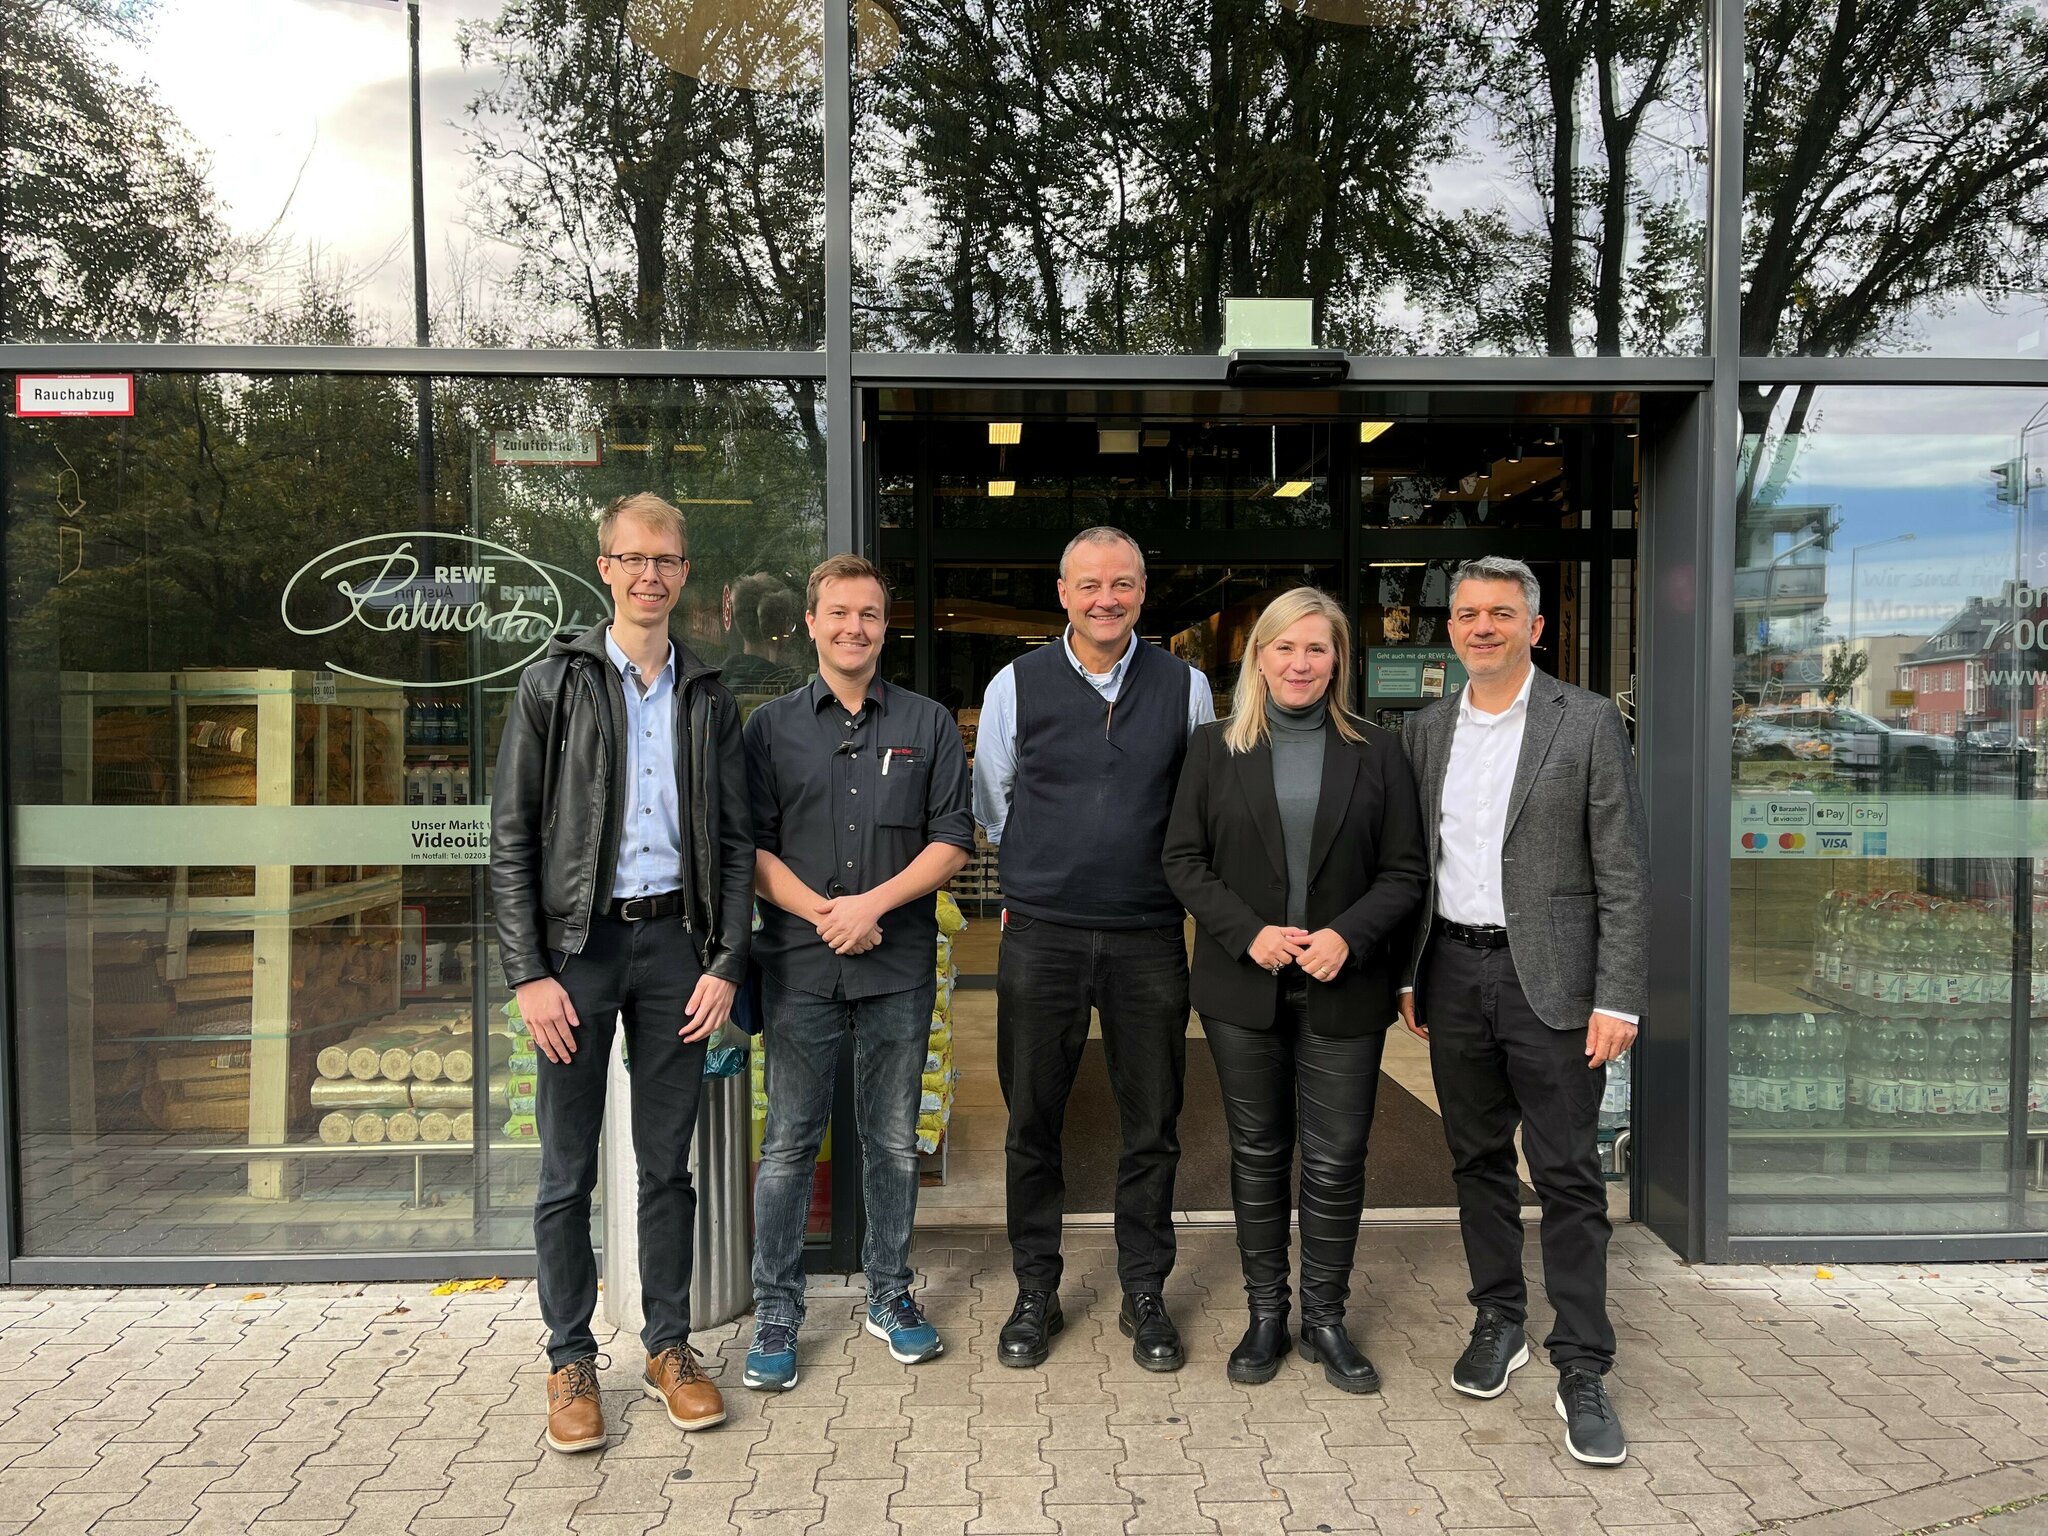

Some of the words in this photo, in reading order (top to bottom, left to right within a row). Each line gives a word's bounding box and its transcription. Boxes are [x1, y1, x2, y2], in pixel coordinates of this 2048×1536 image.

[34, 388, 114, 402] Rauchabzug
[435, 566, 496, 584] REWE
[1826, 809, 1845, 820] Pay
[1867, 810, 1884, 821] Pay
[411, 820, 446, 830] Unser
[449, 820, 484, 830] Markt
[411, 832, 491, 848] Videoüb
[1821, 838, 1848, 848] VISA
[422, 852, 448, 860] Notfall:
[450, 852, 462, 860] Tel.
[464, 852, 487, 860] 02203
